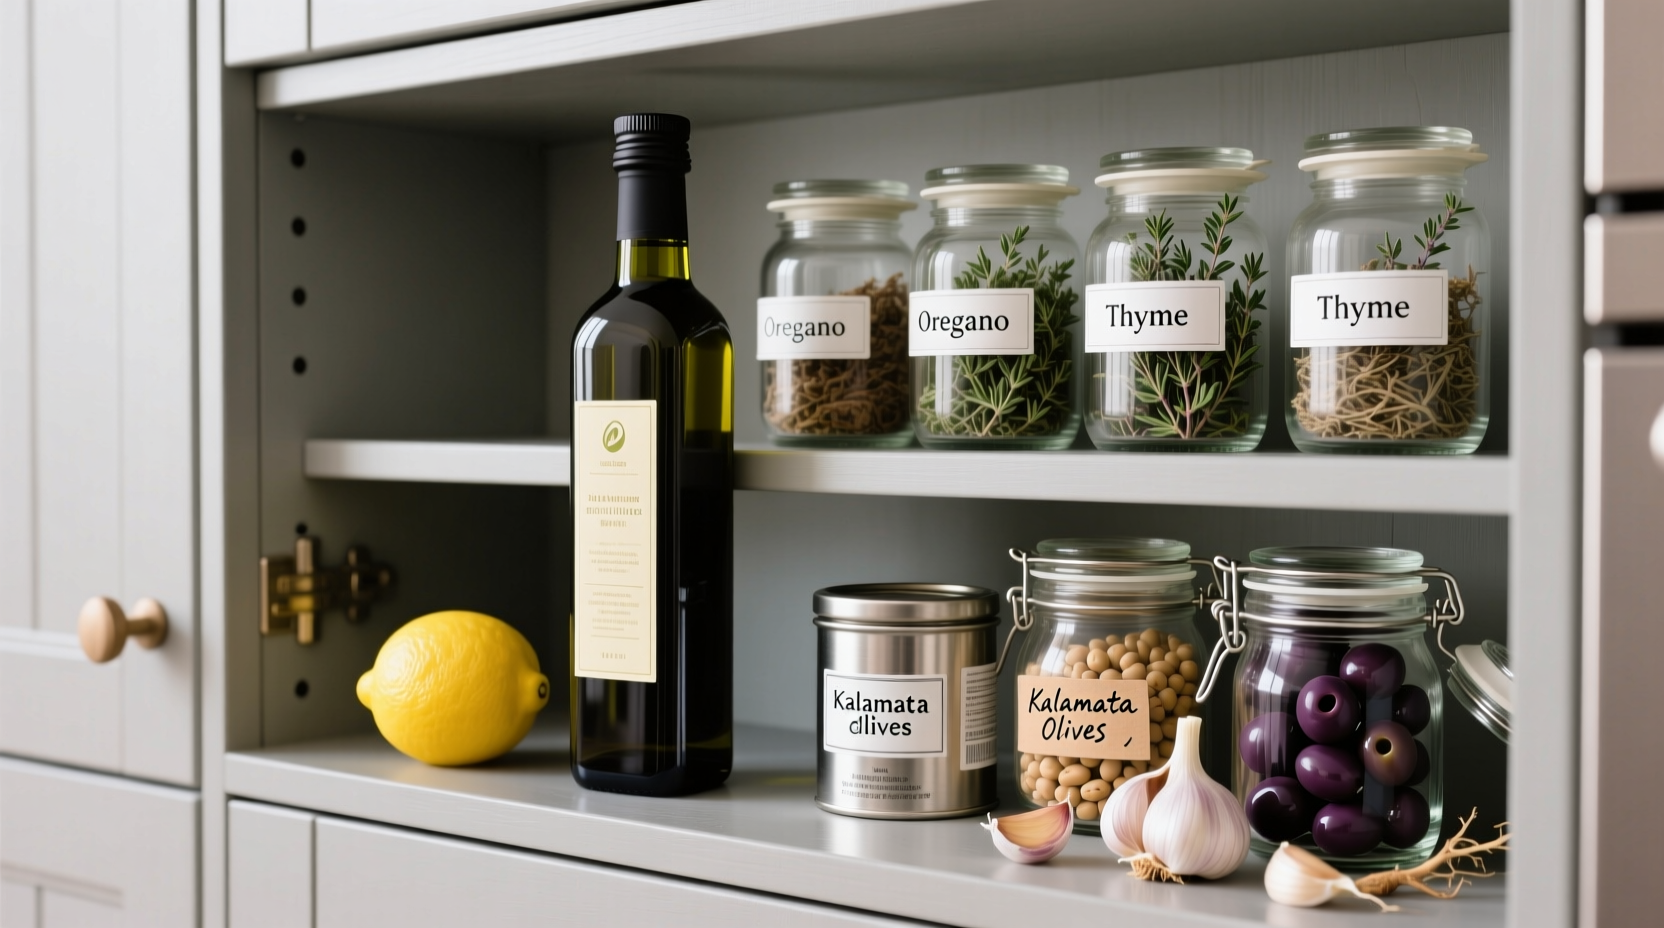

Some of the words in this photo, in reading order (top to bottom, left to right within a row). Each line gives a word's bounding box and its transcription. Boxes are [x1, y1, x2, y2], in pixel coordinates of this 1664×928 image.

[918, 310, 1010, 339] Oregano
[1105, 303, 1189, 335] Thyme
[1316, 294, 1410, 327] Thyme
[764, 316, 846, 344] Oregano
[833, 689, 930, 714] Kalamata
[1028, 687, 1138, 715] Kalamata
[1041, 714, 1107, 743] Olives
